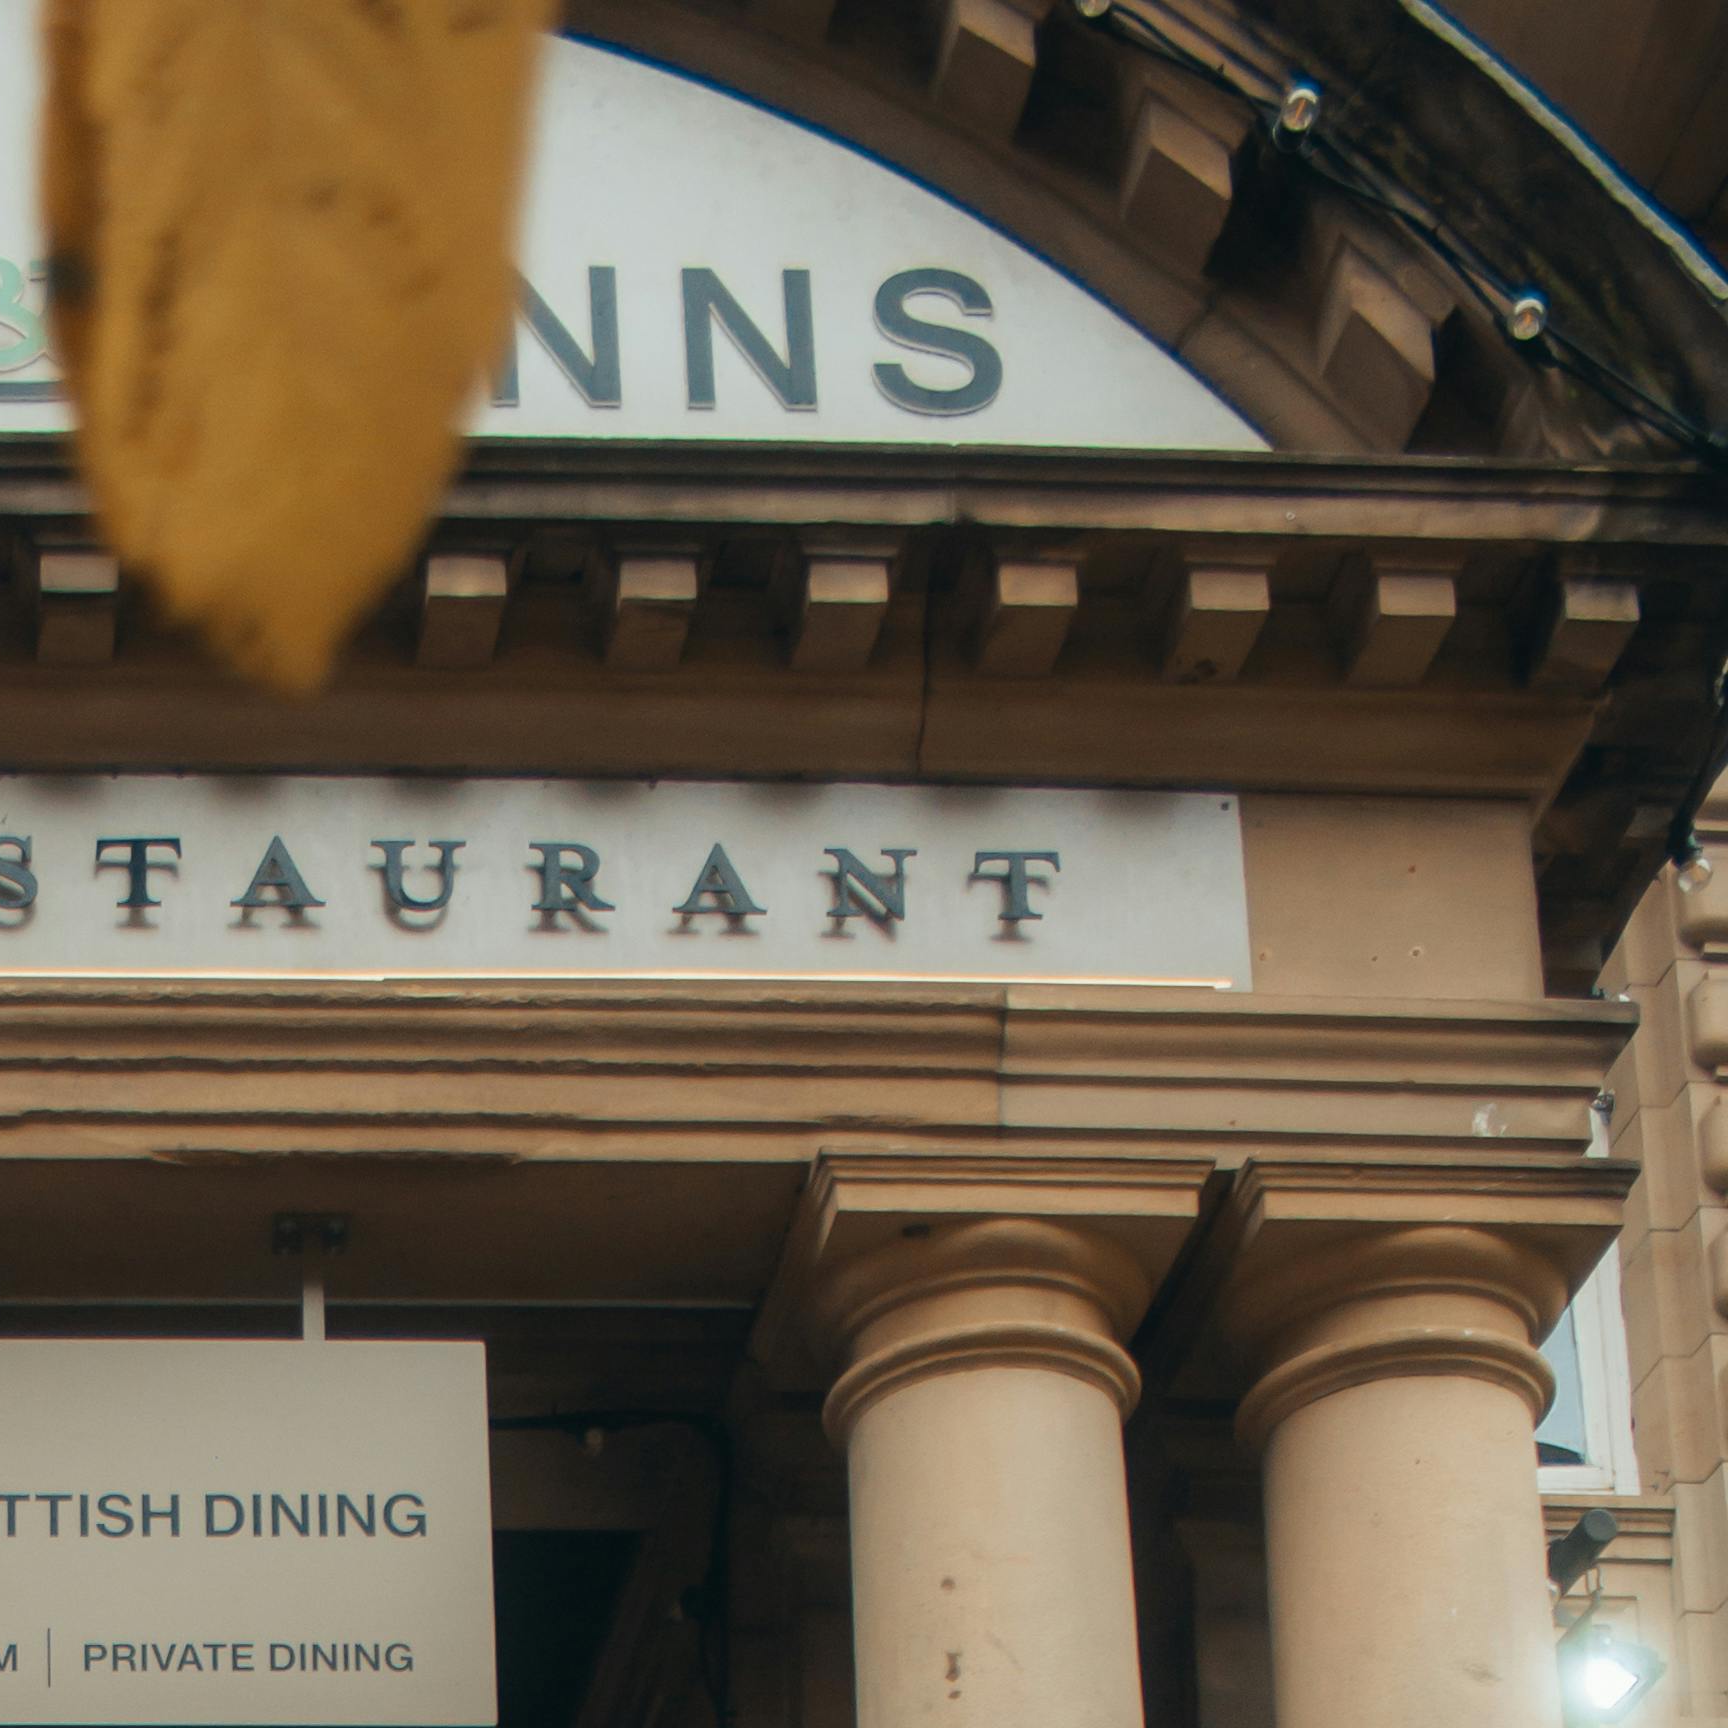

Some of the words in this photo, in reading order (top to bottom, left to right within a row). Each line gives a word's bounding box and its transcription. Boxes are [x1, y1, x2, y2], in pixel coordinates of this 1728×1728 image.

[204, 1492, 429, 1540] DINING
[83, 1643, 257, 1675] PRIVATE
[269, 1642, 416, 1675] DINING
